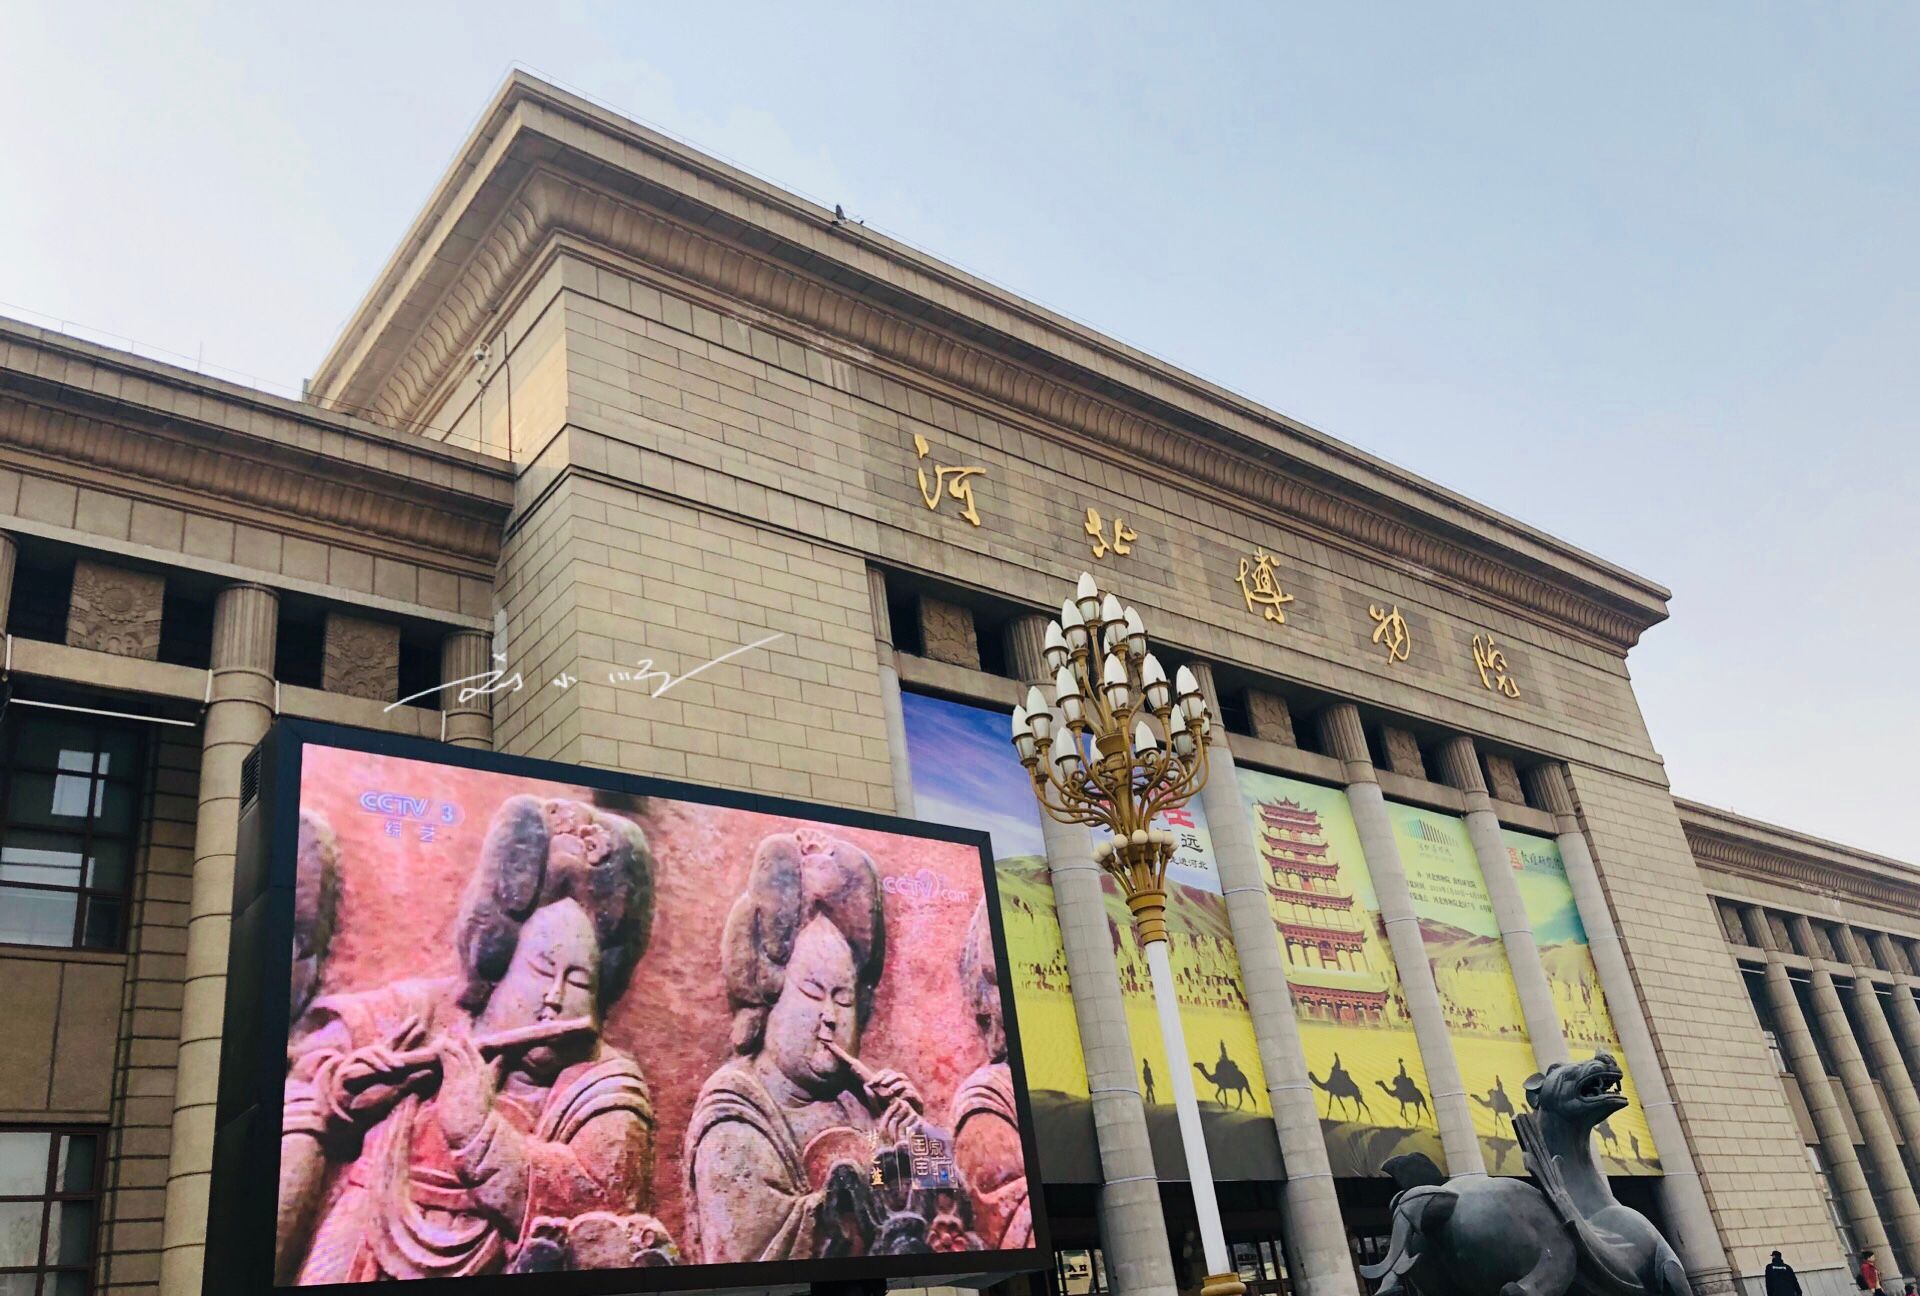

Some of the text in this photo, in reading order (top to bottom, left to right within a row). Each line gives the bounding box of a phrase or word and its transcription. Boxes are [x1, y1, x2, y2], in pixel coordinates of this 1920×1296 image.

[914, 433, 1521, 698] 河北博物院
[360, 791, 455, 823] CCTV 3
